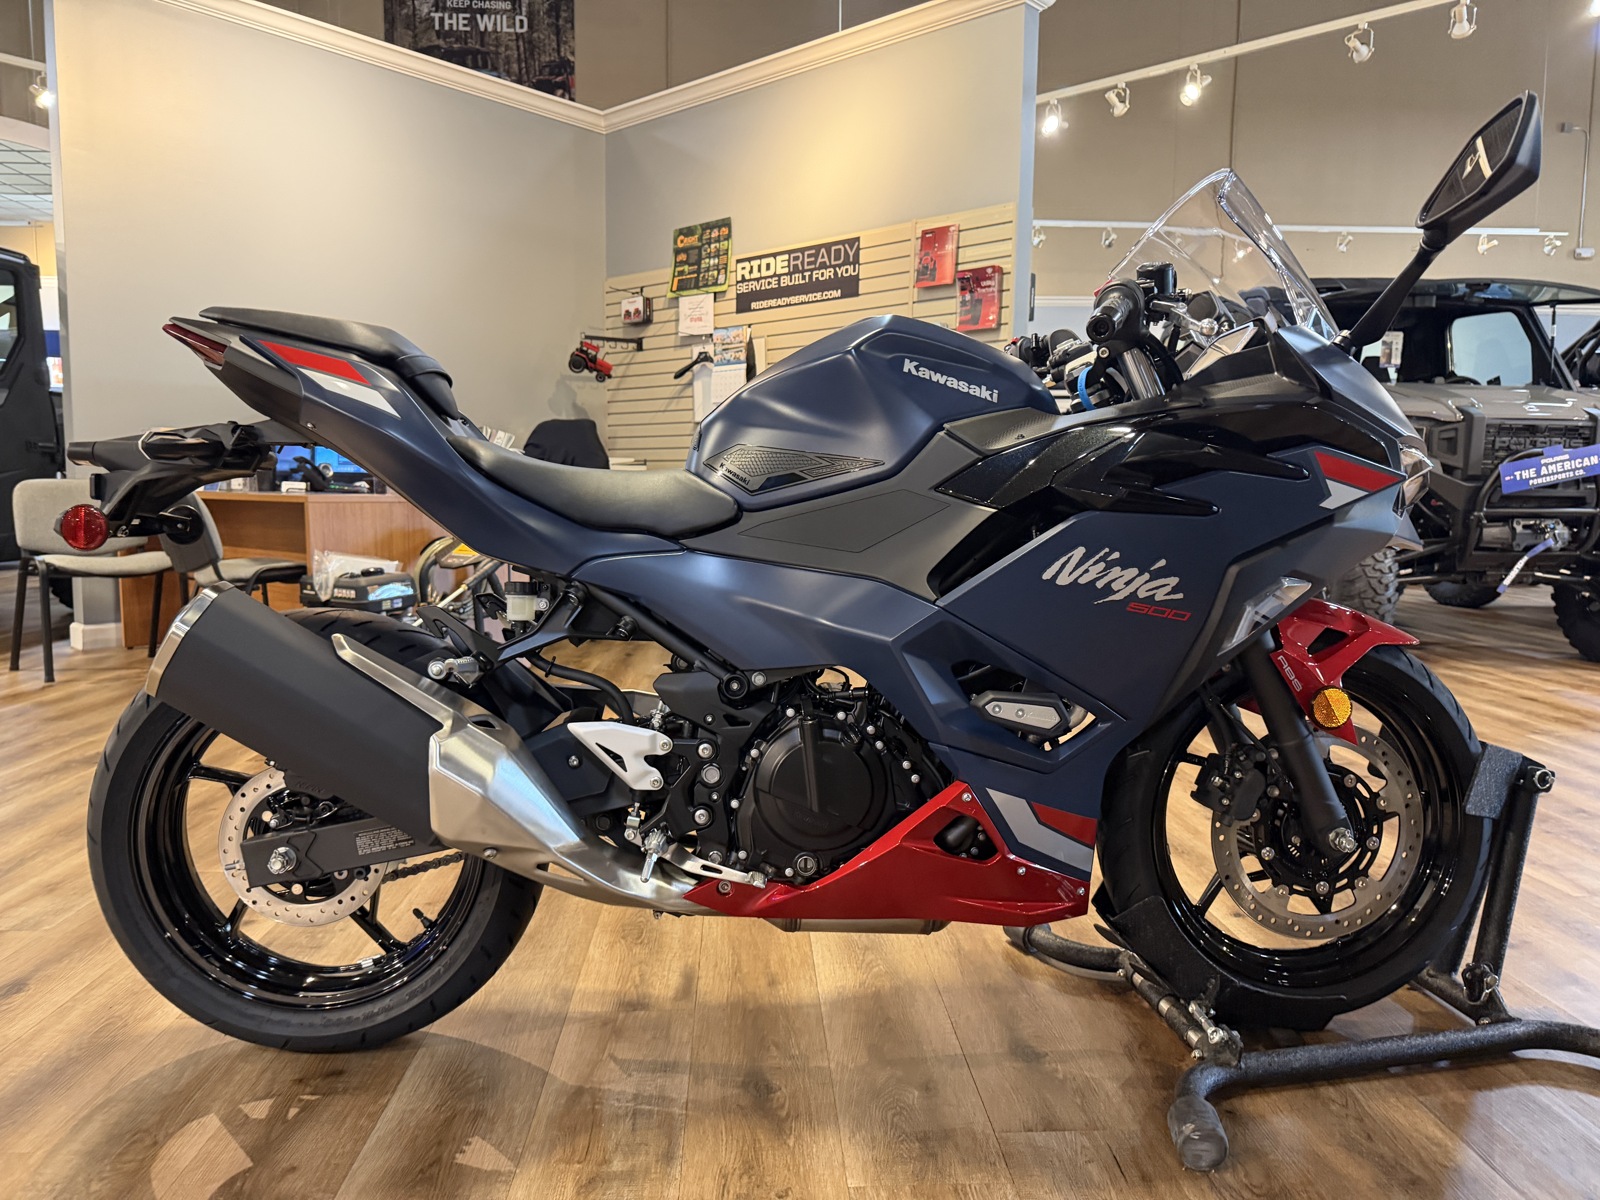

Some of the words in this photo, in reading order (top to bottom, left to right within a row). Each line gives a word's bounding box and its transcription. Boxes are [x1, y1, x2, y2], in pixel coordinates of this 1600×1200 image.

[446, 0, 471, 8] KEEP
[472, 0, 512, 10] CHASING
[431, 13, 471, 32] THE
[476, 13, 528, 33] WILD
[736, 277, 779, 294] SERVICE
[780, 271, 811, 287] BUILT
[813, 267, 834, 282] FOR
[836, 263, 859, 278] YOU
[750, 289, 841, 310] RIDEREADYSERVICE.COM
[903, 358, 999, 404] Kawasaki
[719, 462, 751, 486] Kwasaki
[1514, 467, 1537, 481] THE
[1540, 455, 1599, 476] AMERICAN
[1528, 471, 1574, 486] POWERSPORTS
[1041, 546, 1184, 605] Ninja
[1126, 602, 1191, 622] 500
[1277, 655, 1303, 693] ABS
